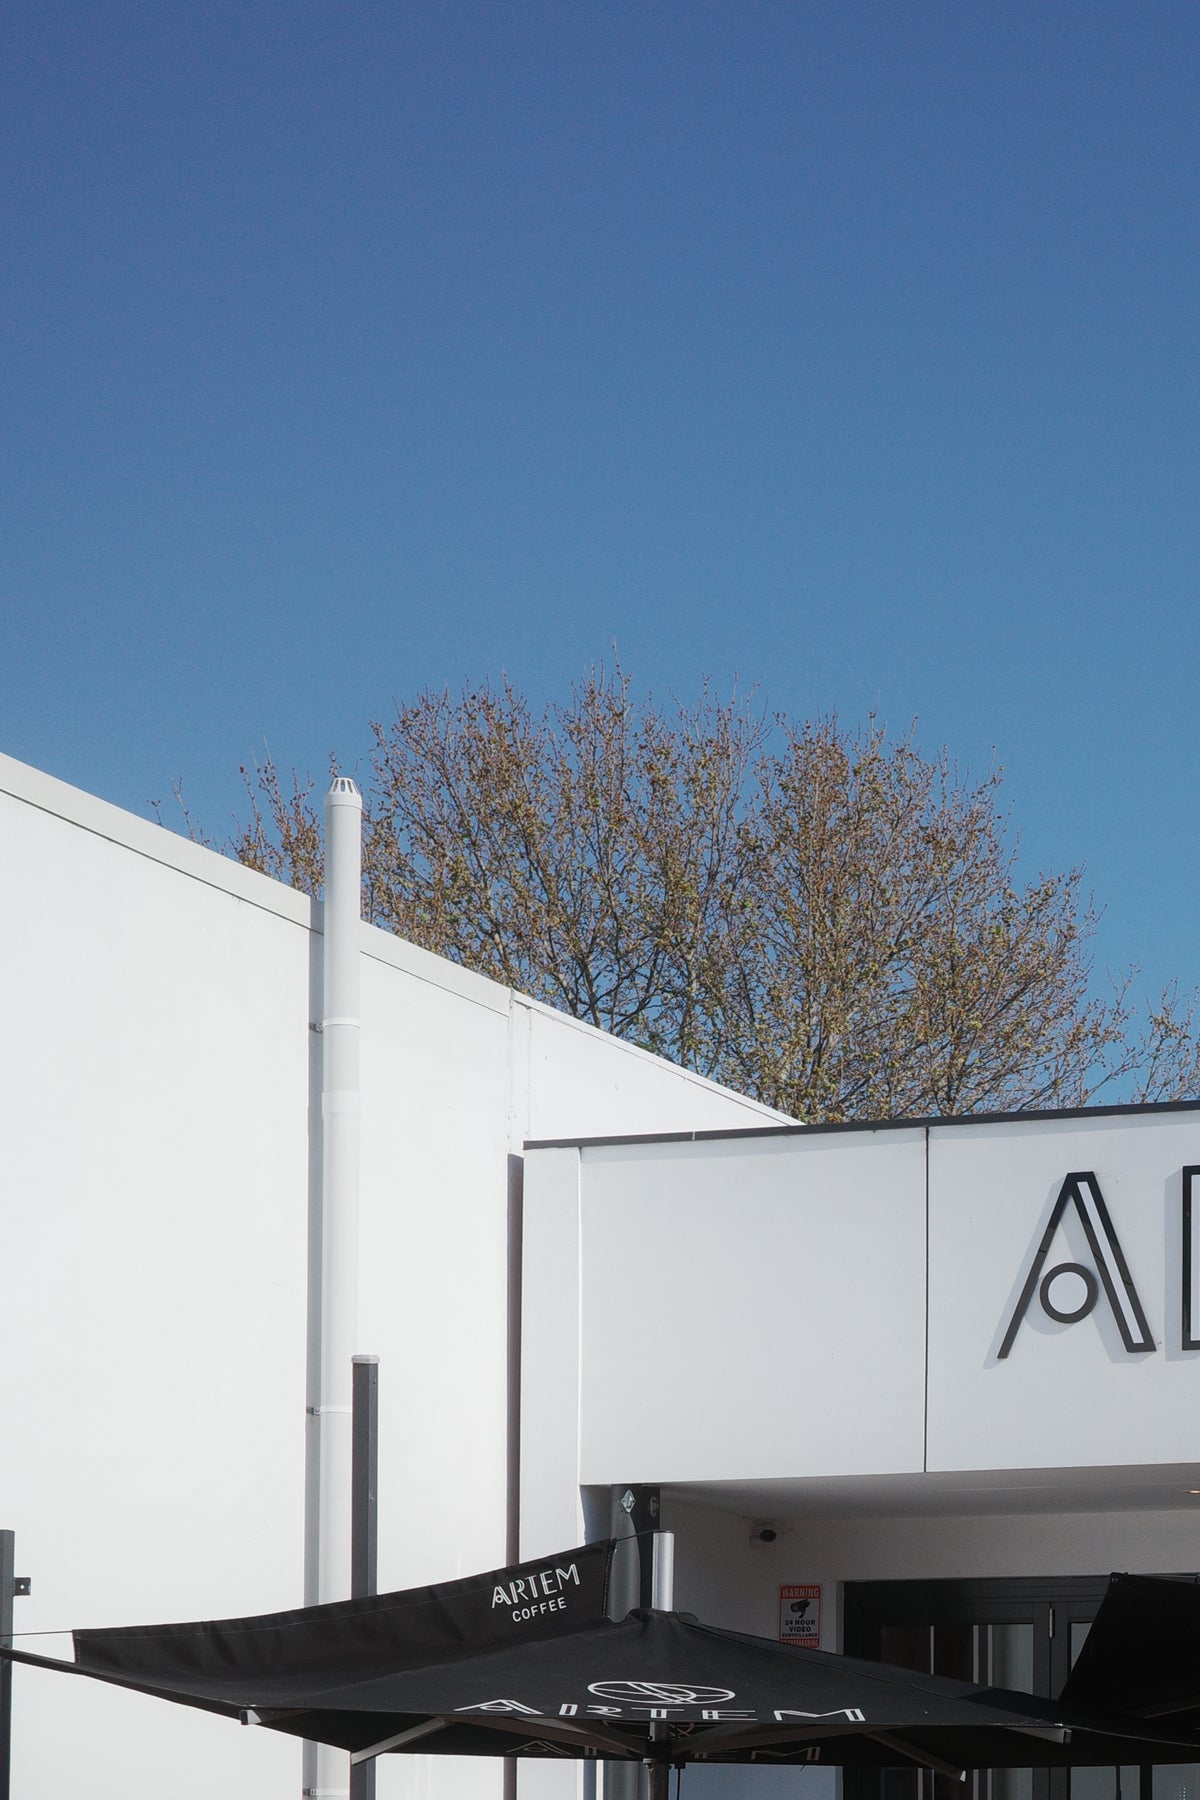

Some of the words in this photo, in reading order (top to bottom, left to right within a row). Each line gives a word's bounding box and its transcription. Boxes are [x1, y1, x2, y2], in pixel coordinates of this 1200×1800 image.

[491, 1563, 580, 1609] ARTEM
[782, 1587, 819, 1598] WARNING
[512, 1597, 567, 1622] COFFEE
[453, 1699, 866, 1722] ARTEM
